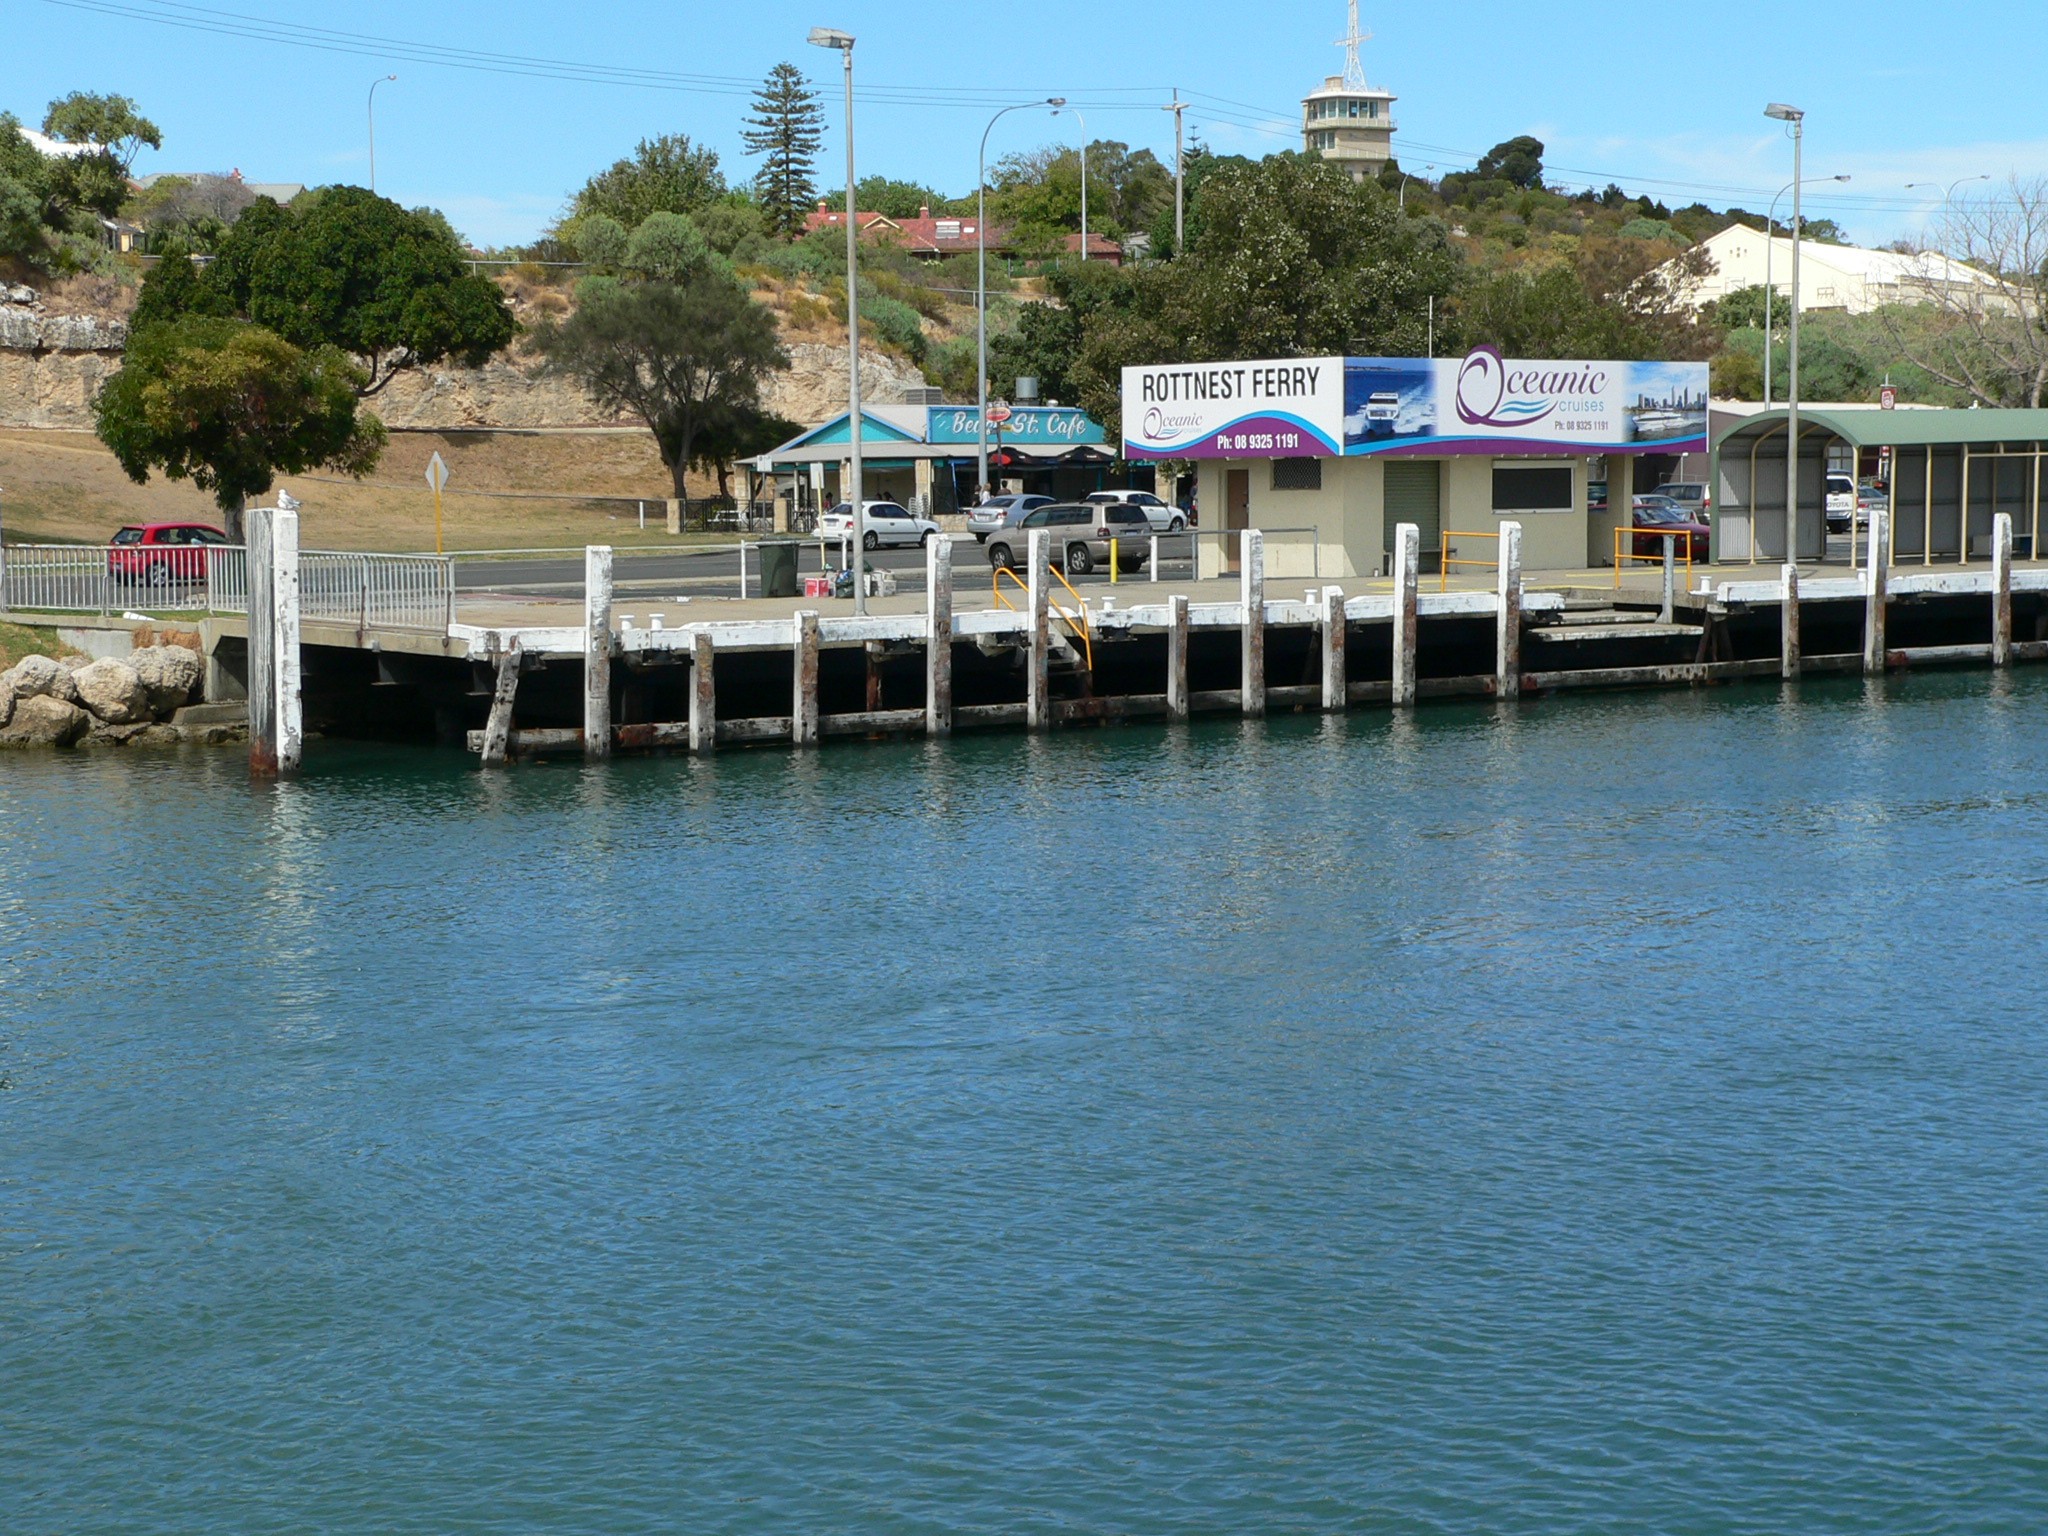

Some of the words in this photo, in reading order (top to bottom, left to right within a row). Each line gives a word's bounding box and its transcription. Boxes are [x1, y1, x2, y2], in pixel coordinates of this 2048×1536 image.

[1143, 370, 1245, 402] ROTTNEST
[1252, 366, 1320, 398] FERRY
[1456, 344, 1609, 427] Oceanic
[1558, 397, 1605, 412] cruises
[1013, 412, 1039, 434] St.
[1047, 412, 1087, 440] Cafe
[1143, 406, 1203, 441] Oceanic
[1554, 420, 1566, 430] Ph:
[1566, 420, 1575, 431] 08
[1576, 420, 1592, 431] 9325
[1594, 420, 1609, 431] 1191
[1217, 434, 1233, 450] Ph:
[1234, 434, 1247, 450] 08
[1249, 433, 1273, 449] 9325
[1275, 432, 1299, 449] 1191
